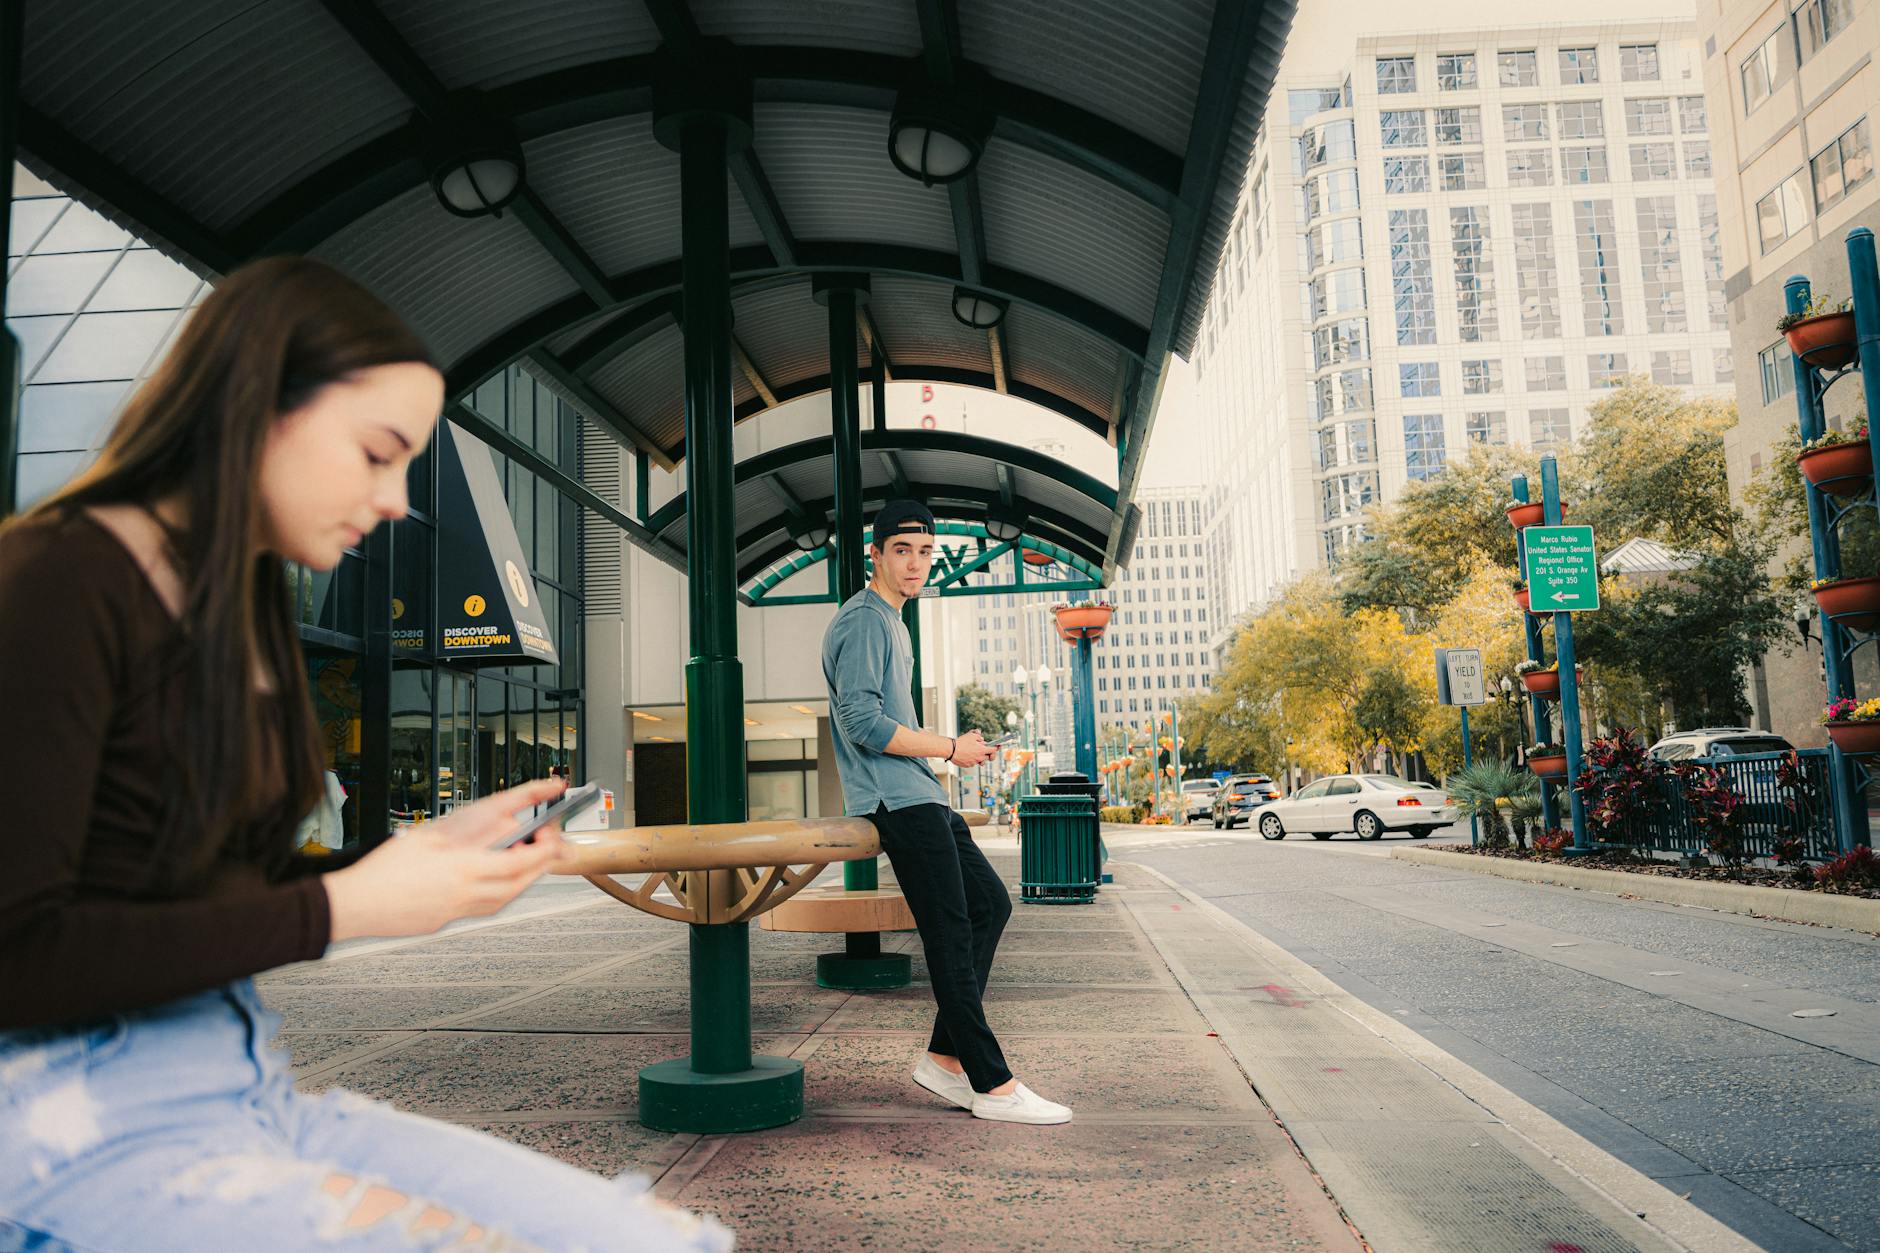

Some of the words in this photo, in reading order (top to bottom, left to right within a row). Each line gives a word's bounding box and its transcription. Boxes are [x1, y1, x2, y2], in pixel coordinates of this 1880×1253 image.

[1528, 546, 1547, 554] United
[1570, 545, 1592, 553] Senator
[1539, 556, 1564, 565] Regional
[1557, 567, 1578, 575] Orange
[1566, 576, 1578, 584] 350
[444, 627, 498, 636] DISCOVER
[444, 635, 511, 646] DOWNTOWN
[1455, 666, 1476, 677] YIELD
